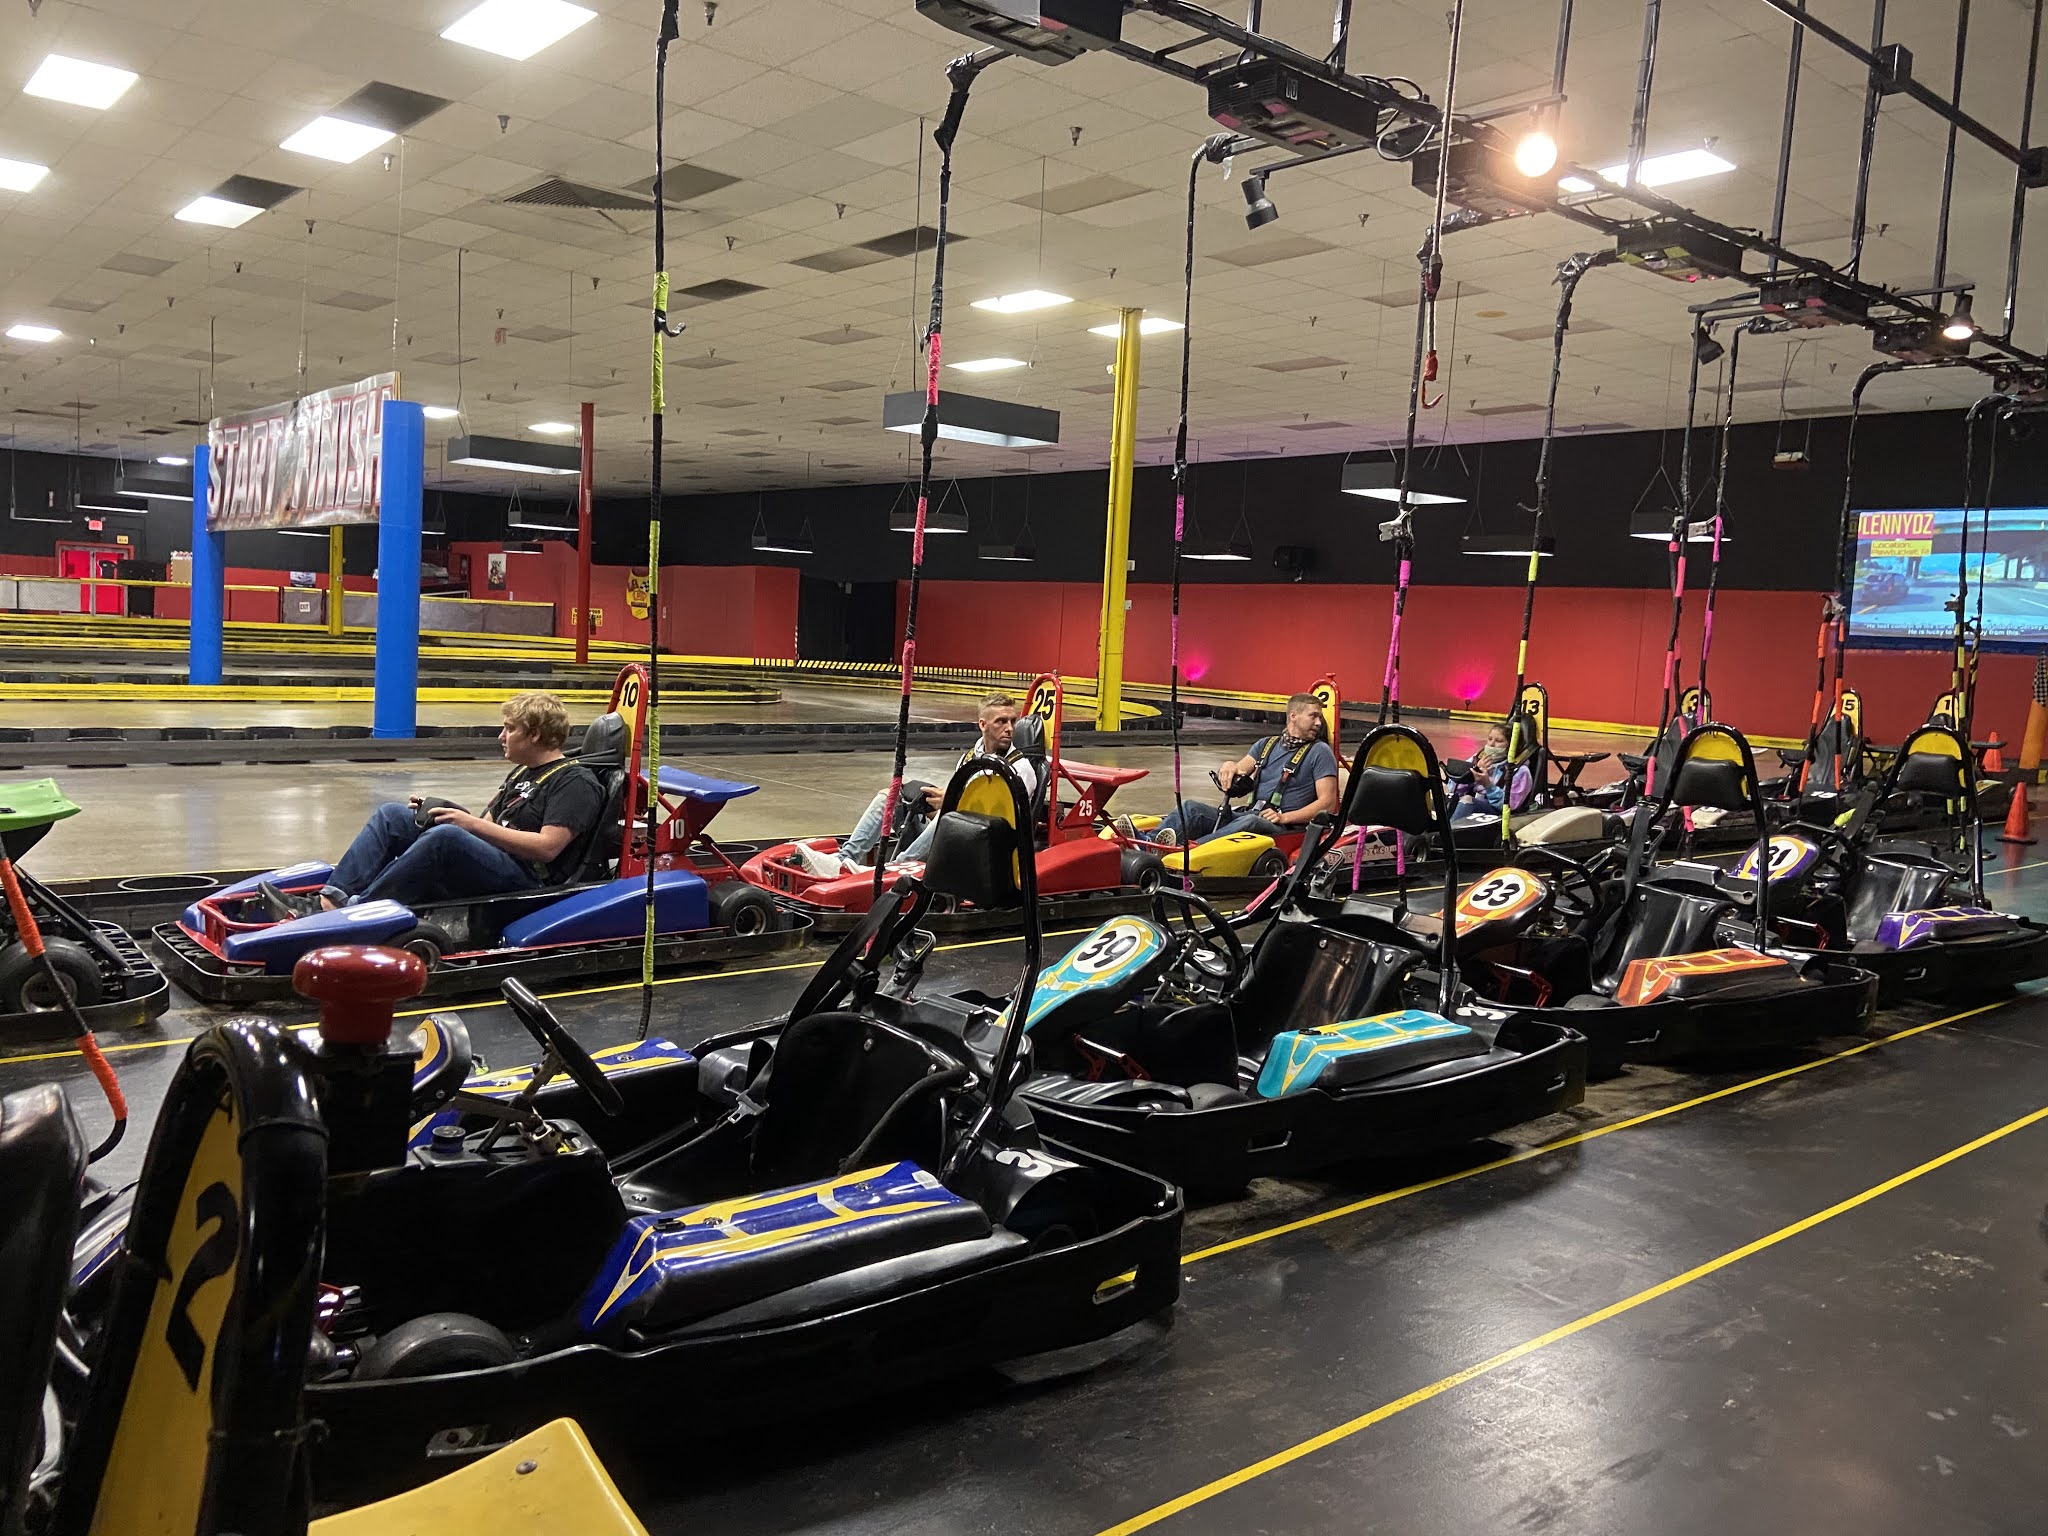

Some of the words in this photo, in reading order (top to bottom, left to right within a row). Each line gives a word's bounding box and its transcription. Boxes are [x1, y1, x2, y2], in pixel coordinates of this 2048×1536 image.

[207, 416, 284, 519] START
[622, 681, 639, 708] 10
[1033, 688, 1056, 720] 25
[1318, 691, 1330, 708] 2
[1522, 699, 1540, 715] 13
[1078, 799, 1093, 817] 25
[1465, 812, 1499, 823] 13
[668, 818, 685, 840] 10
[1226, 834, 1257, 843] 2
[1472, 878, 1521, 907] 33
[340, 899, 401, 922] 10
[1076, 930, 1137, 969] 39
[166, 1181, 240, 1396] 2
